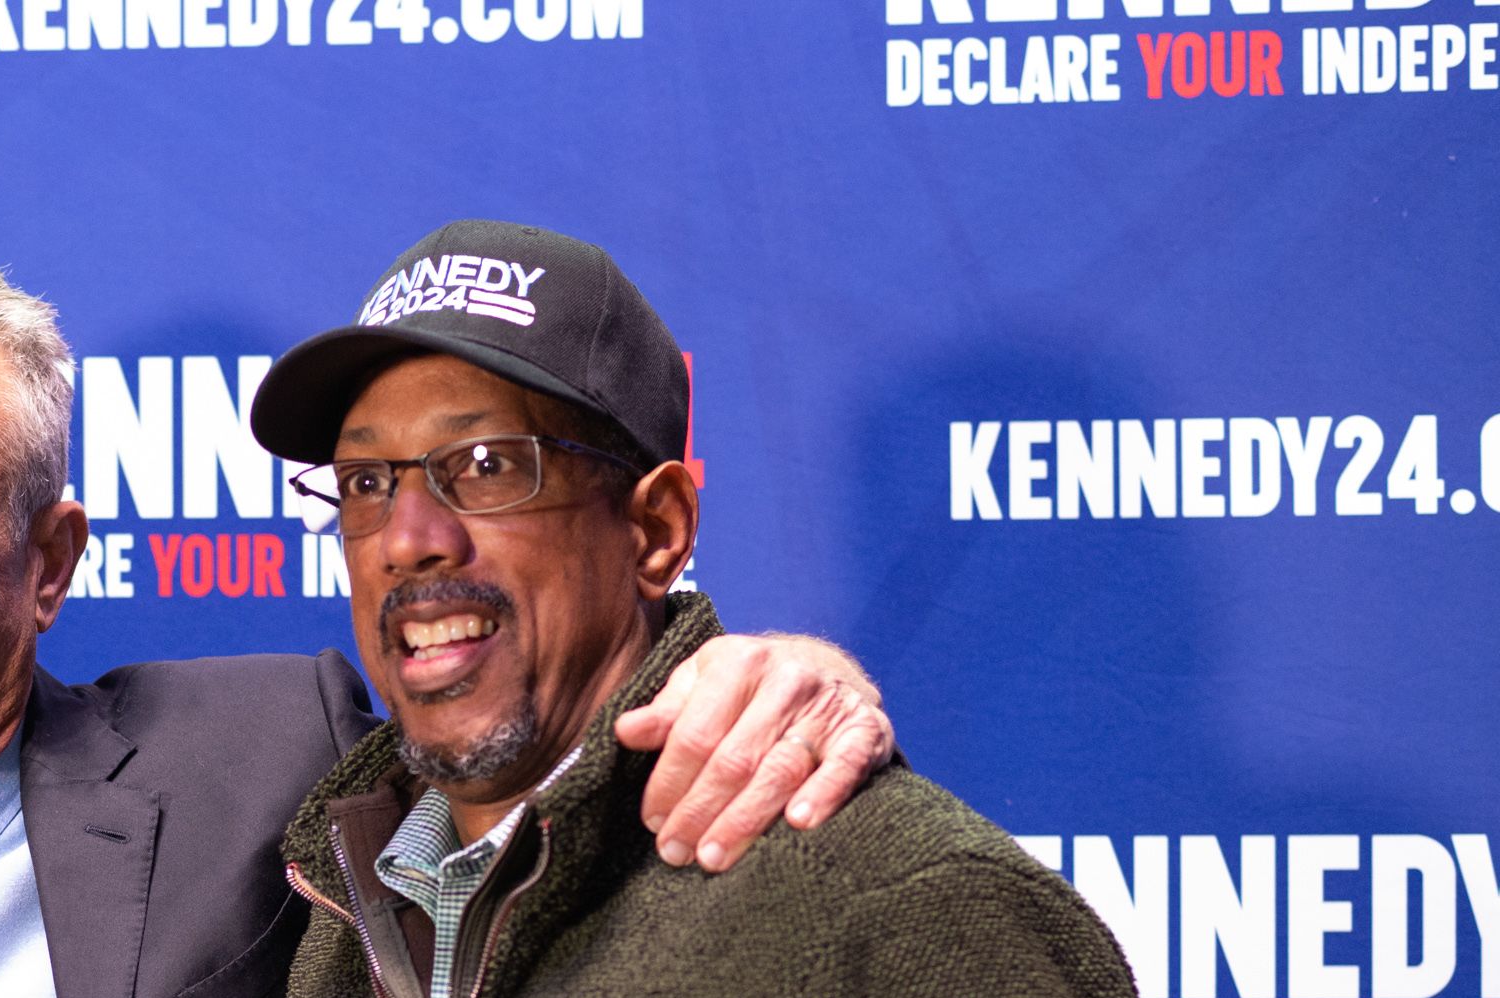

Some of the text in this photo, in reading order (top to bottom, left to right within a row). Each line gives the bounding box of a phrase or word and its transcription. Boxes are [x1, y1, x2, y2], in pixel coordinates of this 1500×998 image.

[886, 23, 1500, 107] DECLARE YOUR INDEPE
[382, 285, 469, 327] 2024
[148, 533, 287, 598] YOUR
